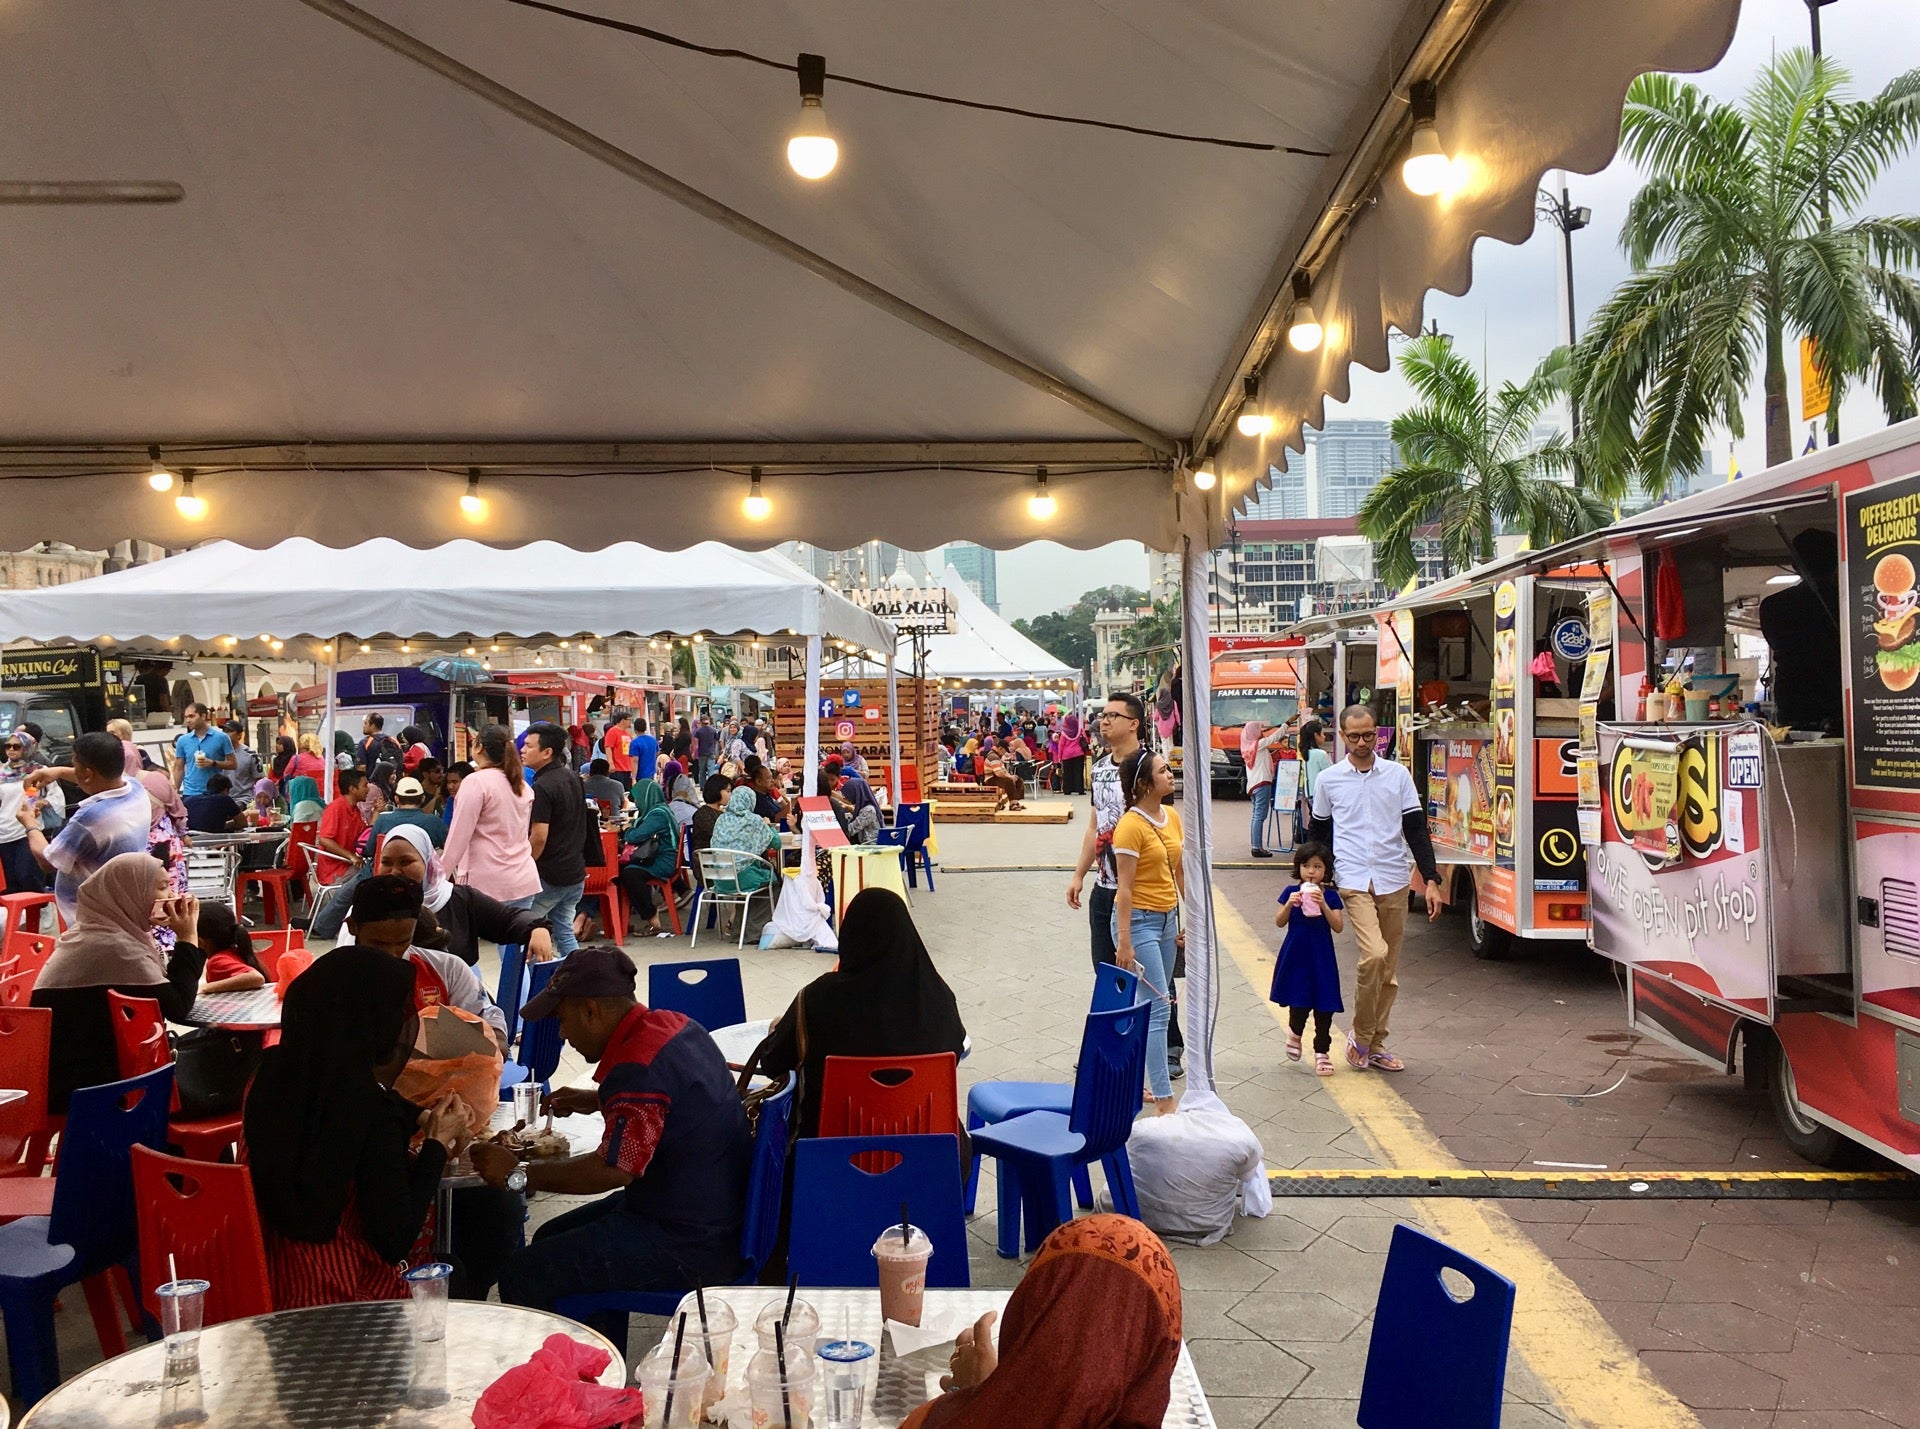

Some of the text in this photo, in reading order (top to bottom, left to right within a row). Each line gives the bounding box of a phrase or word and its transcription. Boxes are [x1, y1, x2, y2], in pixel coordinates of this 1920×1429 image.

[1867, 516, 1917, 547] DELICIOUS
[1218, 689, 1240, 697] FAMA
[1731, 758, 1759, 784] OPEN
